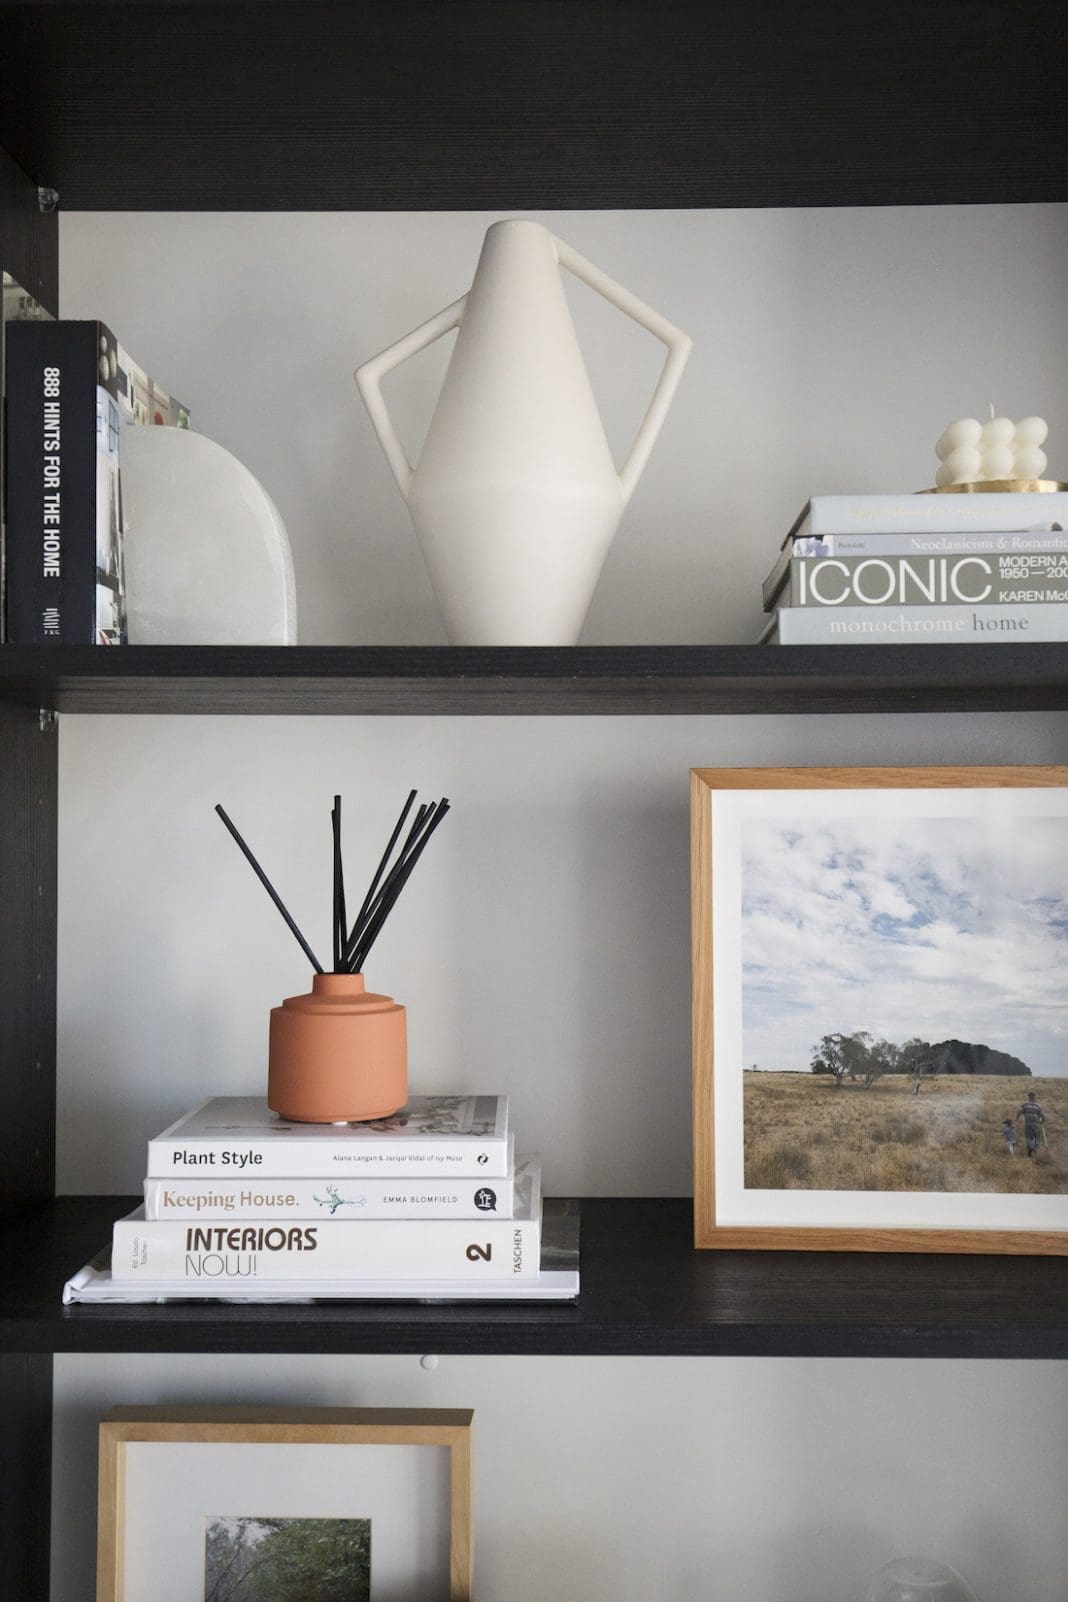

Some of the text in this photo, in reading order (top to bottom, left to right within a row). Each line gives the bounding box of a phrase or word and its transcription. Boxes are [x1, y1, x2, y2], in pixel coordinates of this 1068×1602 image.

[44, 367, 60, 578] 888 HINTS FOR THE HOME
[911, 538, 993, 550] Neoclassicism
[997, 538, 1007, 549] &
[999, 556, 1057, 568] MODERN
[800, 557, 993, 606] ICONIC
[999, 567, 1030, 579] 1950
[999, 590, 1045, 602] KAREN
[830, 612, 1030, 634] monochrome home
[173, 1150, 263, 1169] Plant Style
[333, 1154, 352, 1162] Alana
[353, 1154, 377, 1164] Langan
[408, 1154, 425, 1162] Vidal
[426, 1154, 434, 1162] of
[163, 1191, 300, 1212] Keeping House.
[383, 1196, 459, 1204] EMMA BLOMFIELD
[185, 1227, 318, 1252] INTERIORS
[466, 1242, 492, 1262] 2
[513, 1229, 522, 1274] TASCHEN
[185, 1254, 257, 1277] NOW!
